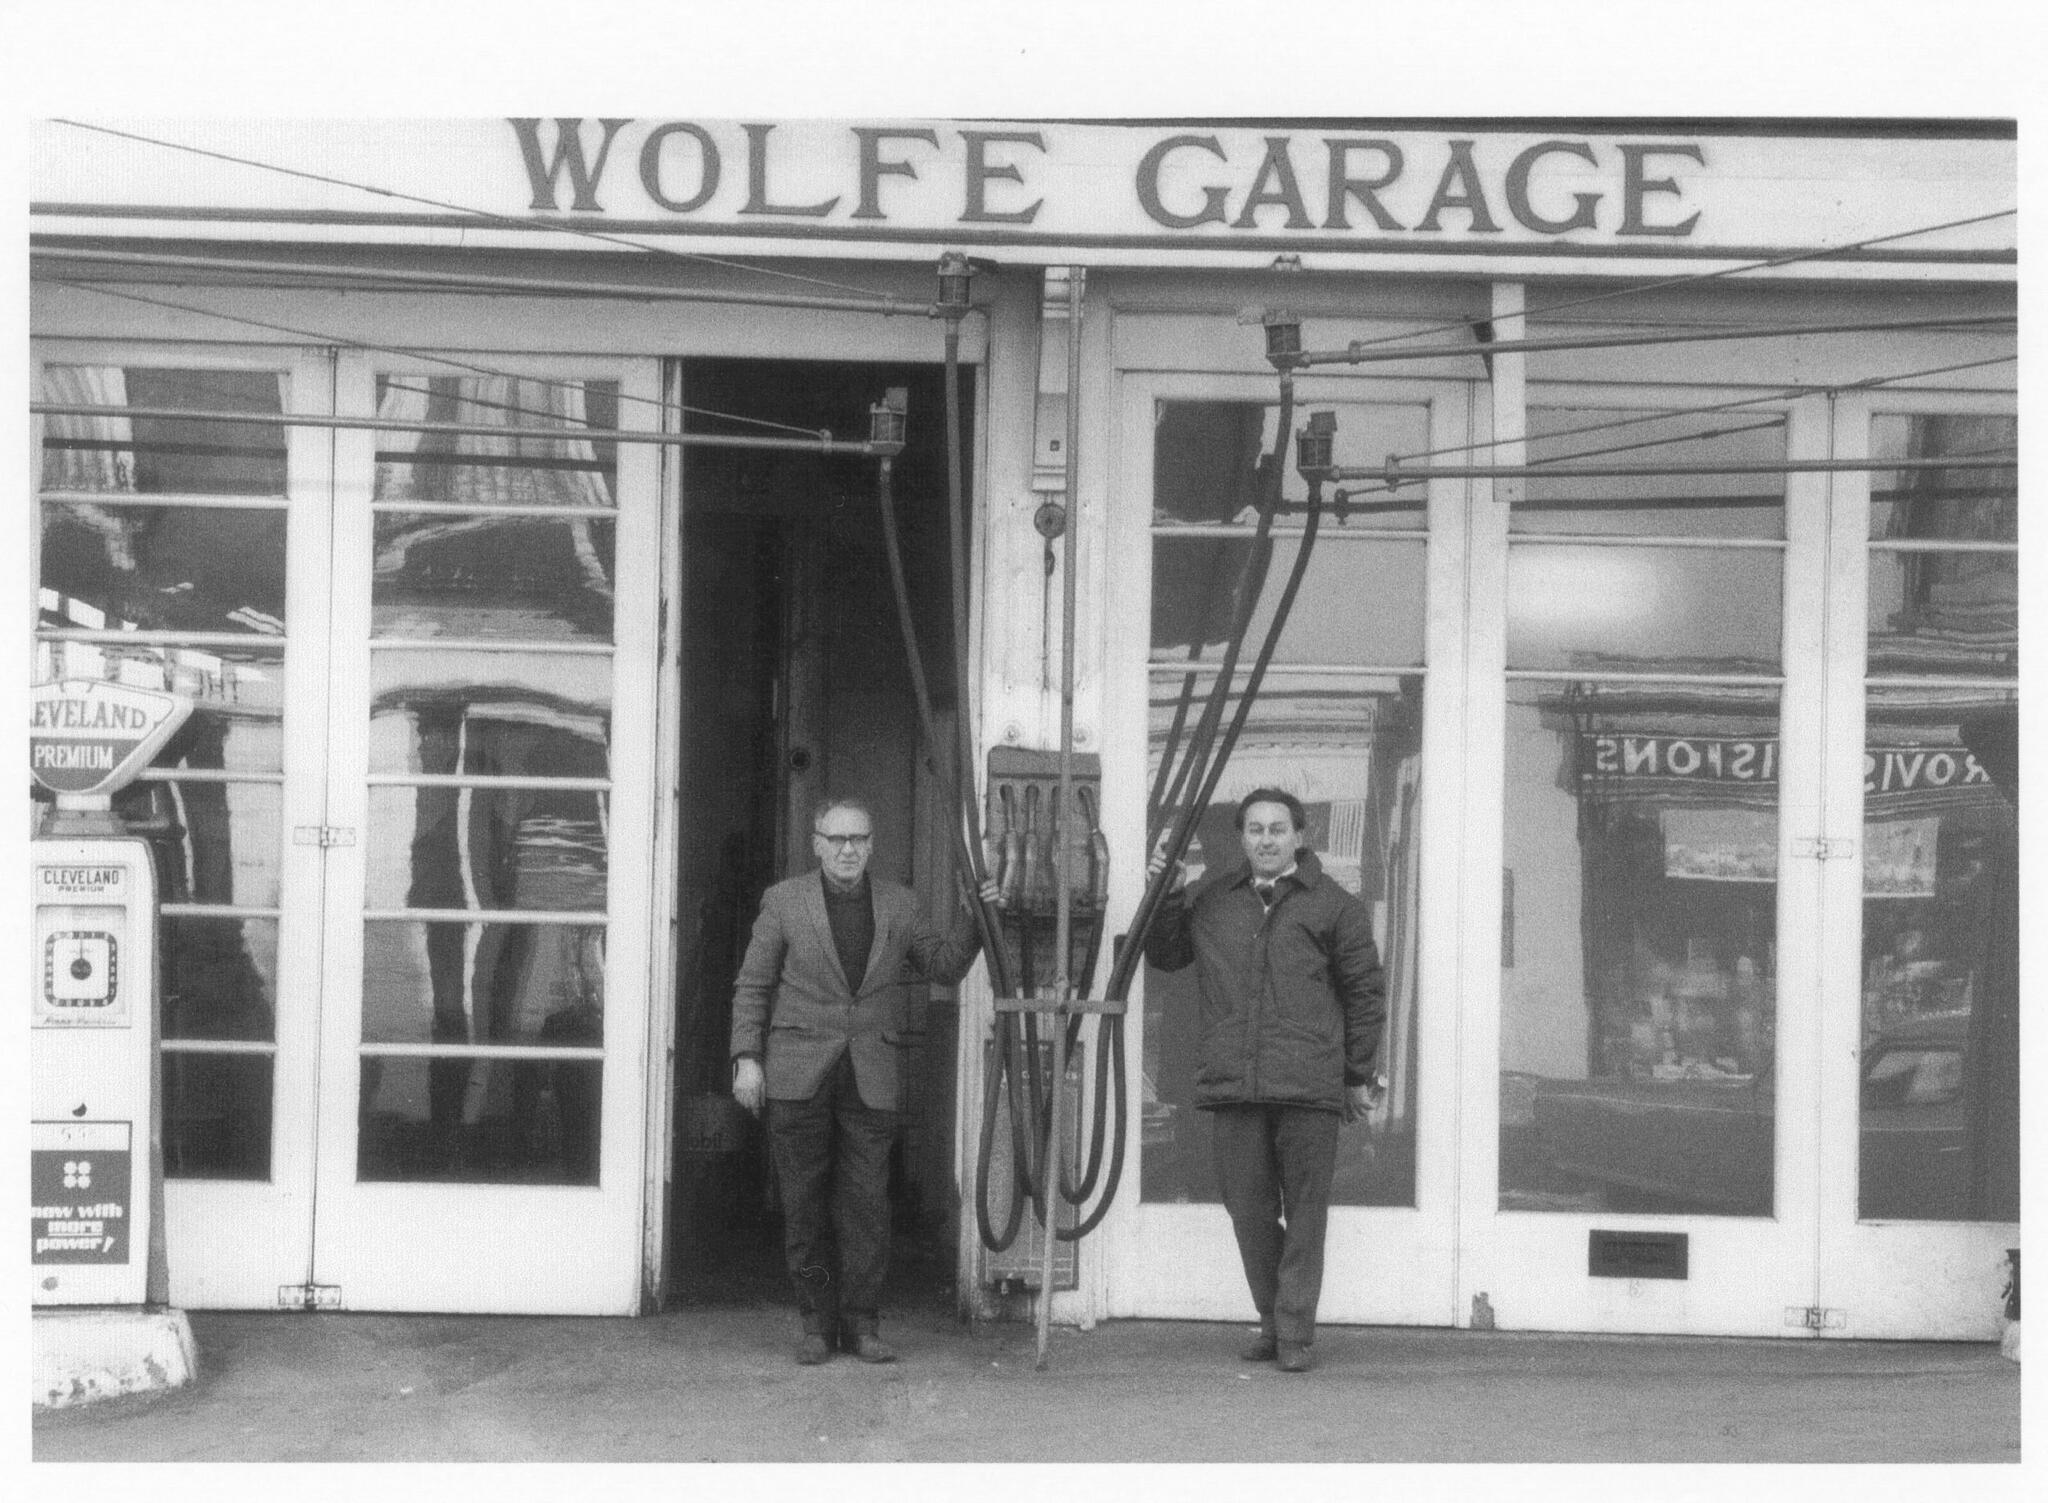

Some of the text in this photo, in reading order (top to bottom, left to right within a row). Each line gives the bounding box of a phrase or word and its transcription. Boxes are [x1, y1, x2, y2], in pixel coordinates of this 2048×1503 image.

[506, 118, 1706, 237] WOLFE GARAGE
[30, 698, 147, 729] EVELAND
[34, 744, 114, 769] PREMIUM
[44, 869, 119, 885] CLEVELAND
[57, 885, 105, 893] PREMIUM
[78, 1203, 123, 1218] with
[48, 1221, 103, 1233] more
